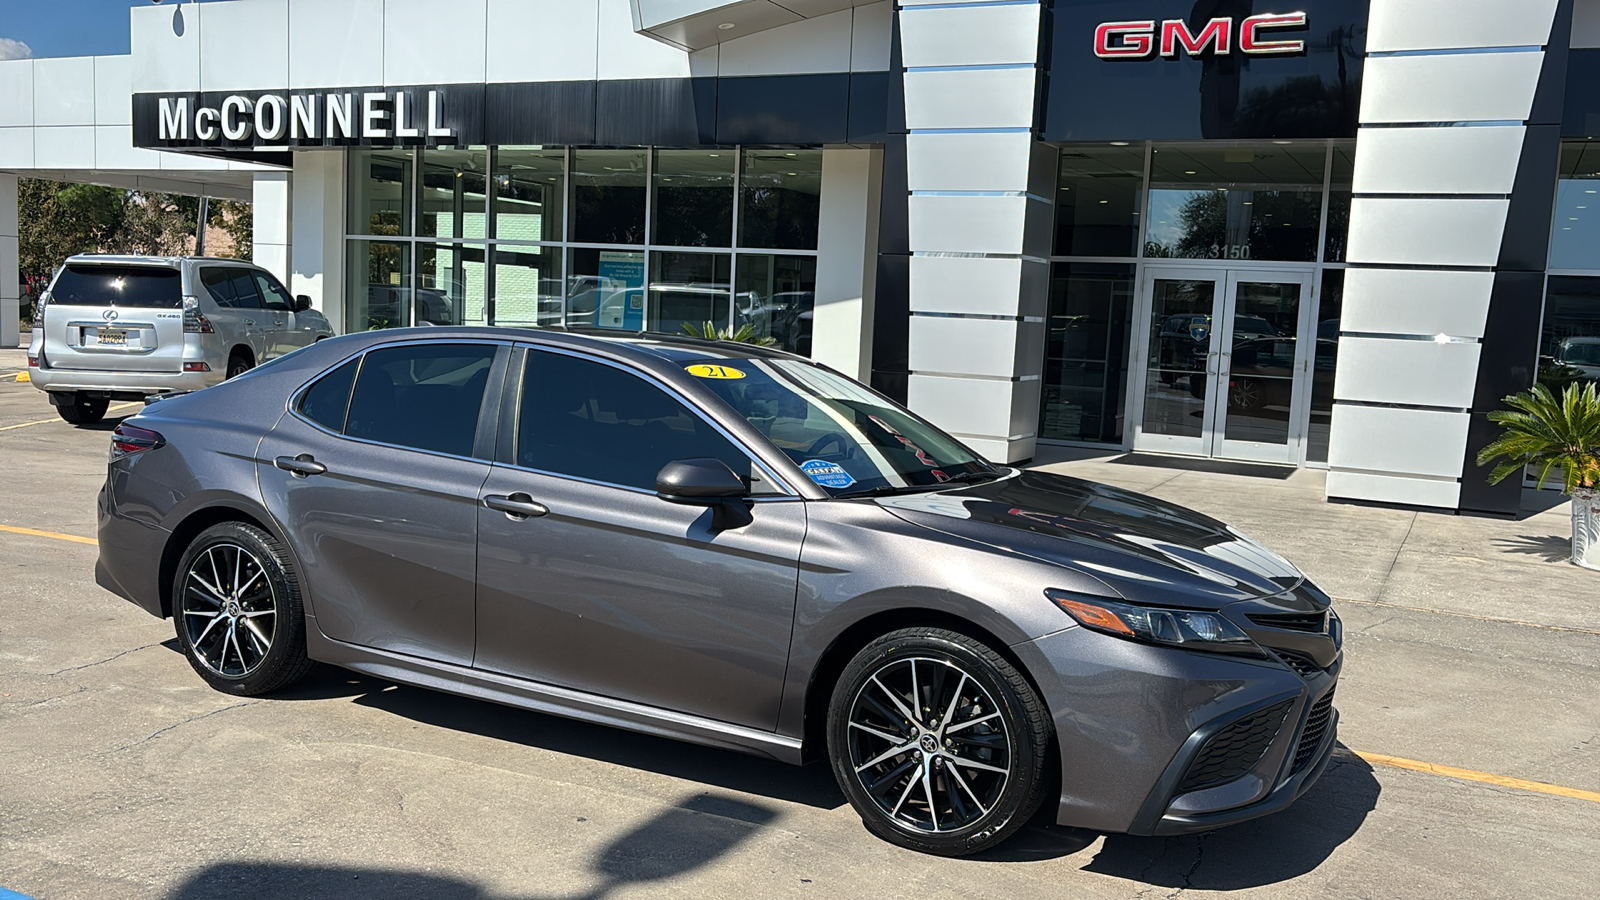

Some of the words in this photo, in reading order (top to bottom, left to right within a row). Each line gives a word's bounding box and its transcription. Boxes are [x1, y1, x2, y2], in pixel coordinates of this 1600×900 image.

[1093, 12, 1306, 58] GMC
[158, 90, 453, 141] McCONNELL
[1210, 244, 1250, 259] 3150
[702, 366, 729, 377] 21
